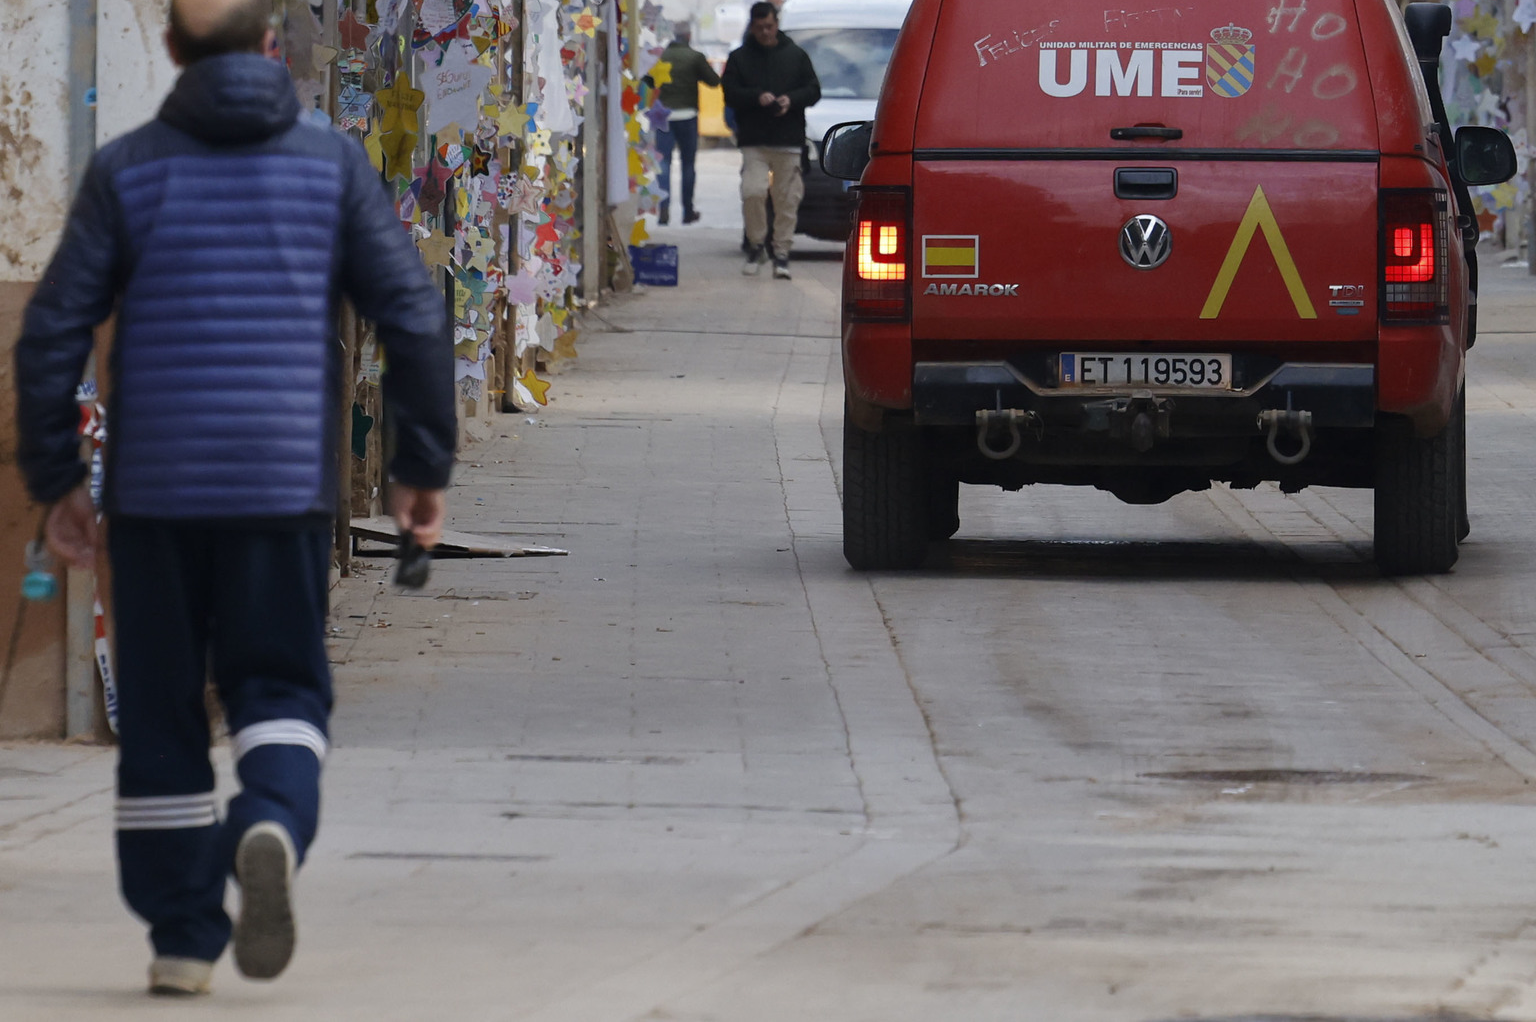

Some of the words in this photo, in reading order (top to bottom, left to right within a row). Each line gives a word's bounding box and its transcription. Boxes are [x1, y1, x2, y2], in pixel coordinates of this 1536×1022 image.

[1135, 42, 1203, 50] EMERGENCIAS
[1039, 50, 1203, 97] UME
[923, 283, 1020, 296] AMAROK
[1329, 285, 1364, 297] TDI
[1123, 358, 1223, 385] 119593
